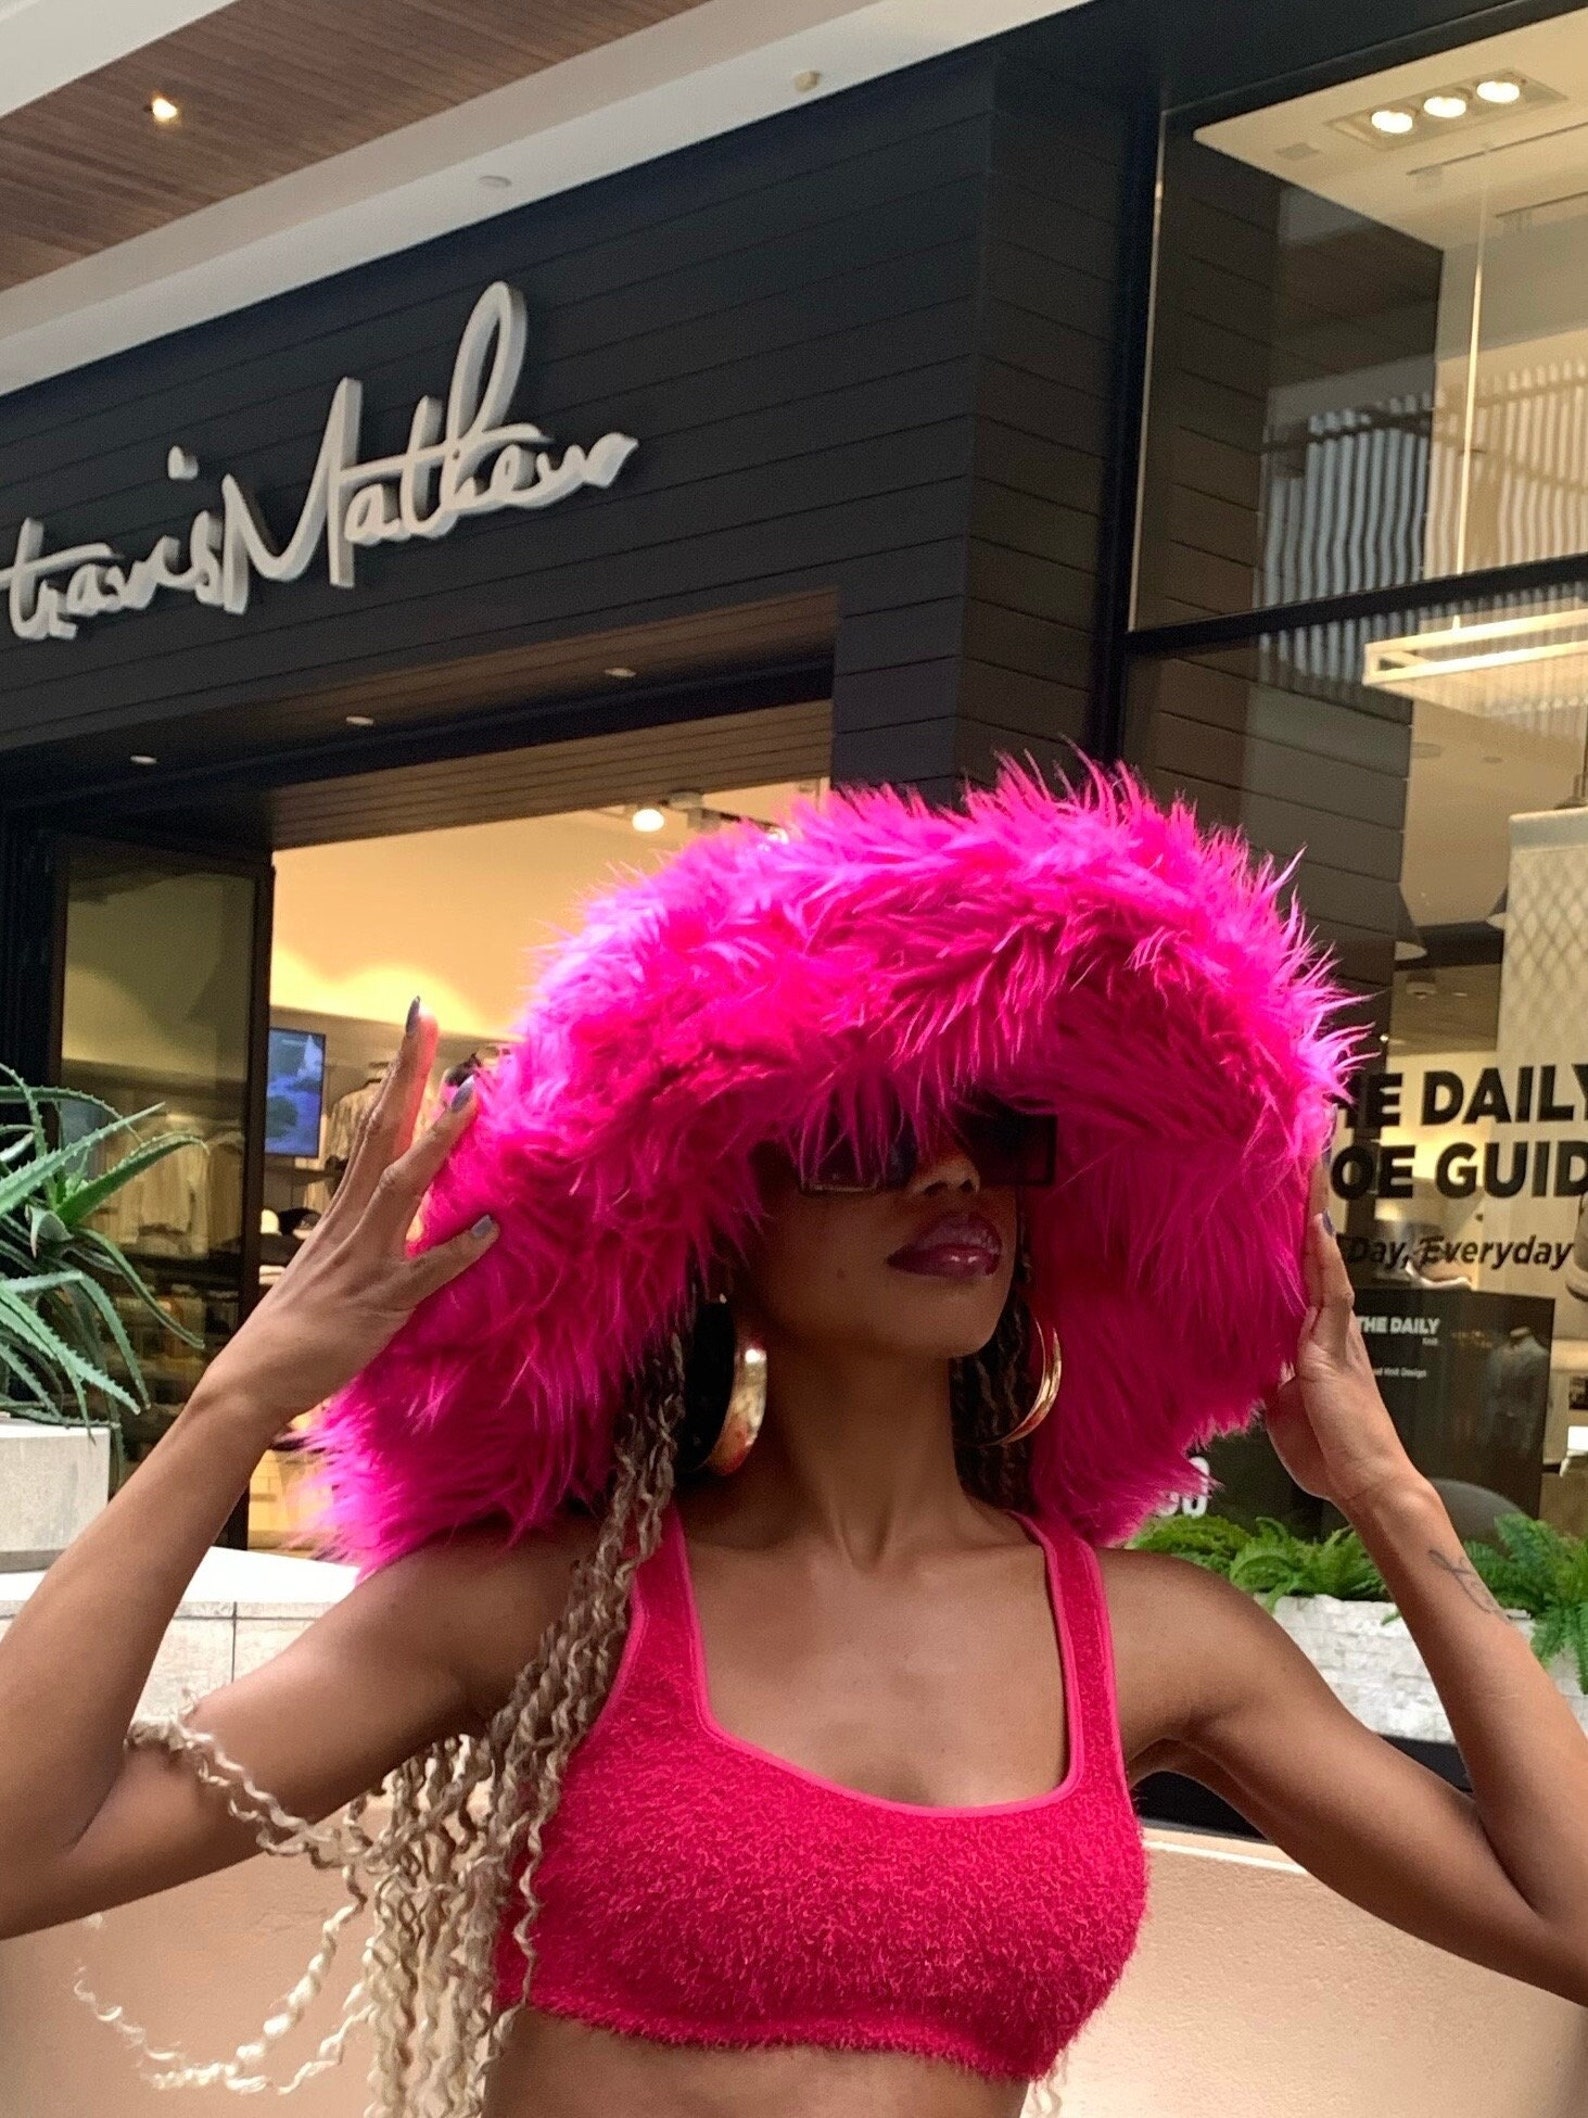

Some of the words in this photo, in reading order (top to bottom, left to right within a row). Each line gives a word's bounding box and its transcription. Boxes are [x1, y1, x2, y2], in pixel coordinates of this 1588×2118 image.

[1330, 1144, 1416, 1201] OE
[1419, 1234, 1576, 1271] Everyday
[1389, 1316, 1440, 1335] DAILY
